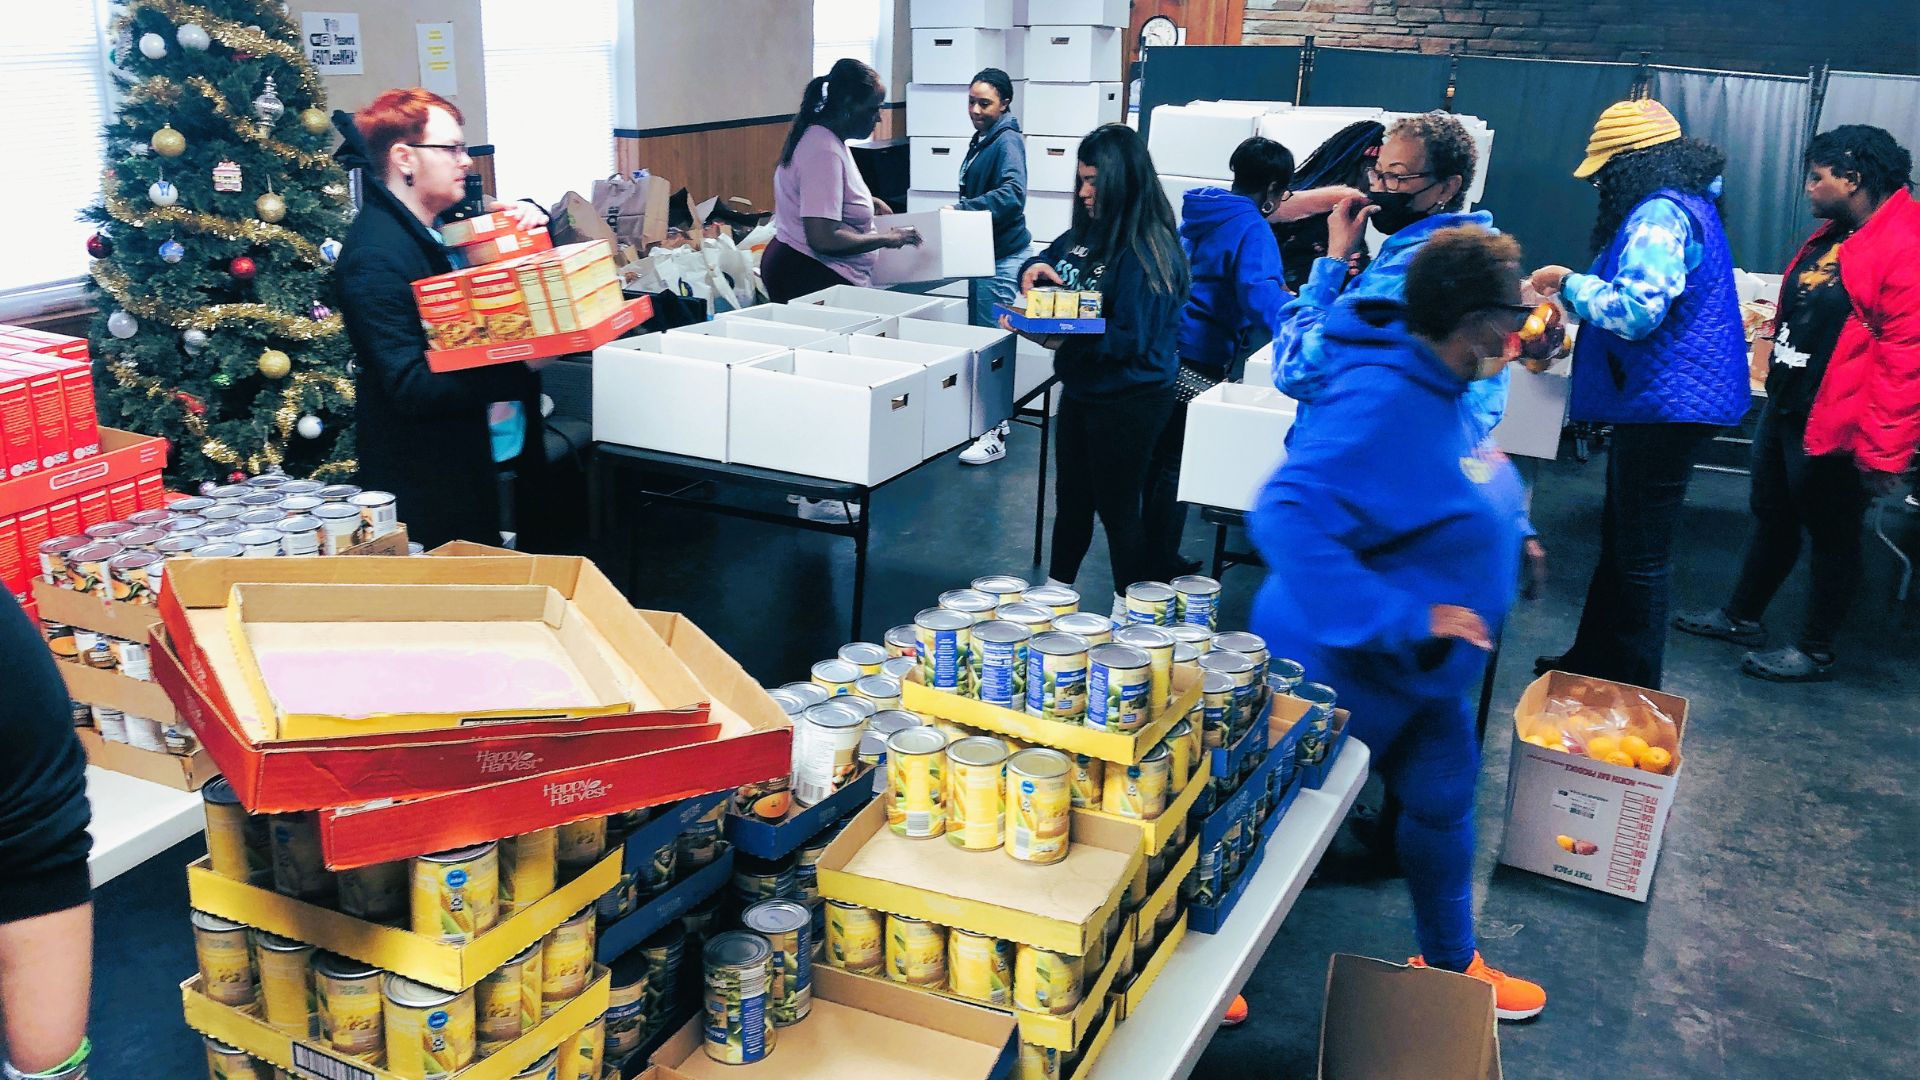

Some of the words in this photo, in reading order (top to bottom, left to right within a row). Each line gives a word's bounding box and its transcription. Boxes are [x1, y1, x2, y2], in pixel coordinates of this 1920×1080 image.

[475, 749, 524, 763] Happy
[480, 757, 540, 773] Harvest
[543, 777, 591, 797] Happy
[550, 785, 609, 806] Harvest
[1552, 863, 1573, 876] PACK
